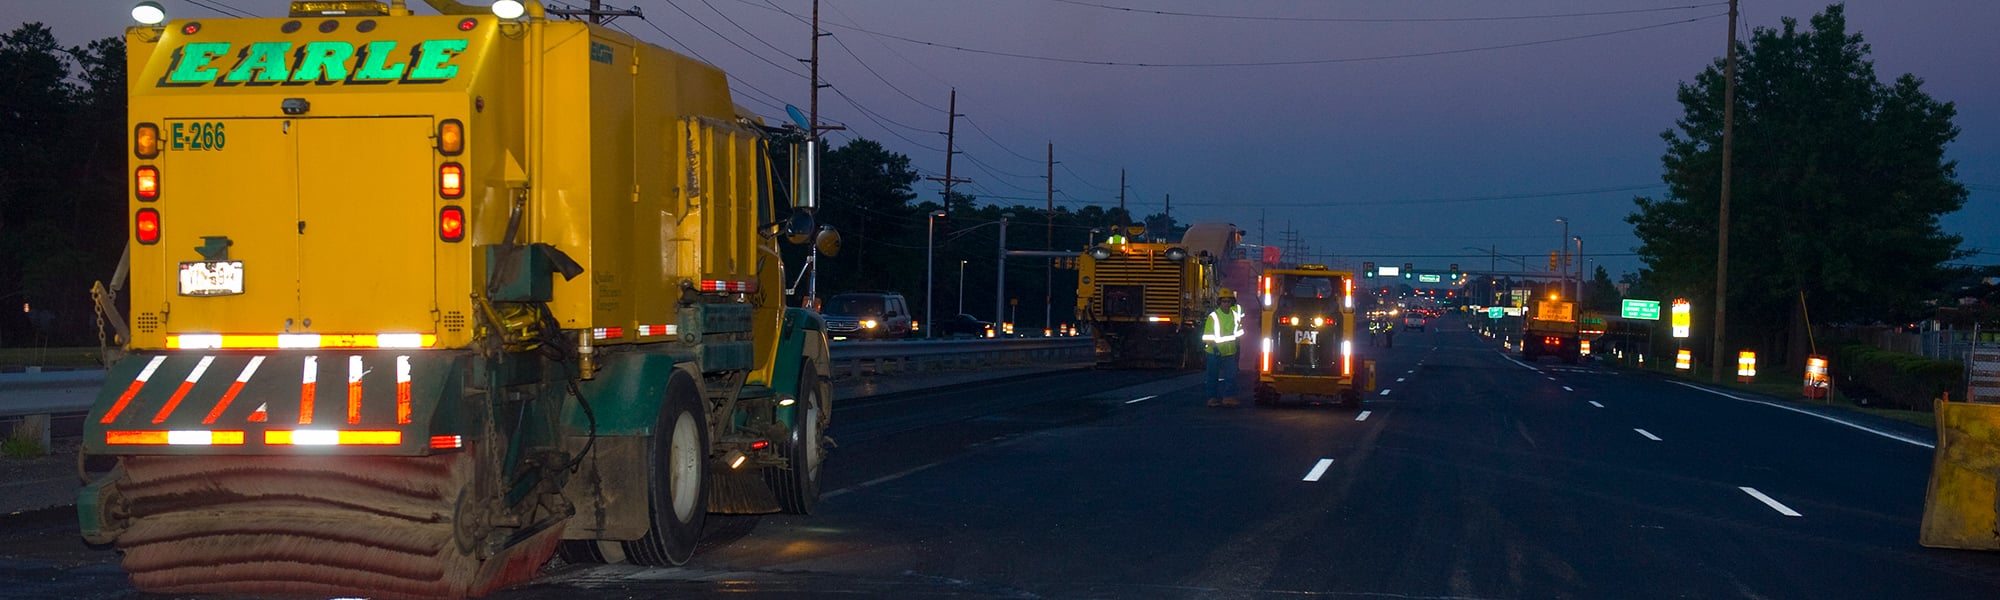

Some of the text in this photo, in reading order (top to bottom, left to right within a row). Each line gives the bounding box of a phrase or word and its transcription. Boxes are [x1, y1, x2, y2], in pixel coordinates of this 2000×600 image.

[157, 39, 469, 87] EARLE
[172, 122, 226, 150] E-266
[1295, 330, 1319, 345] CAT
